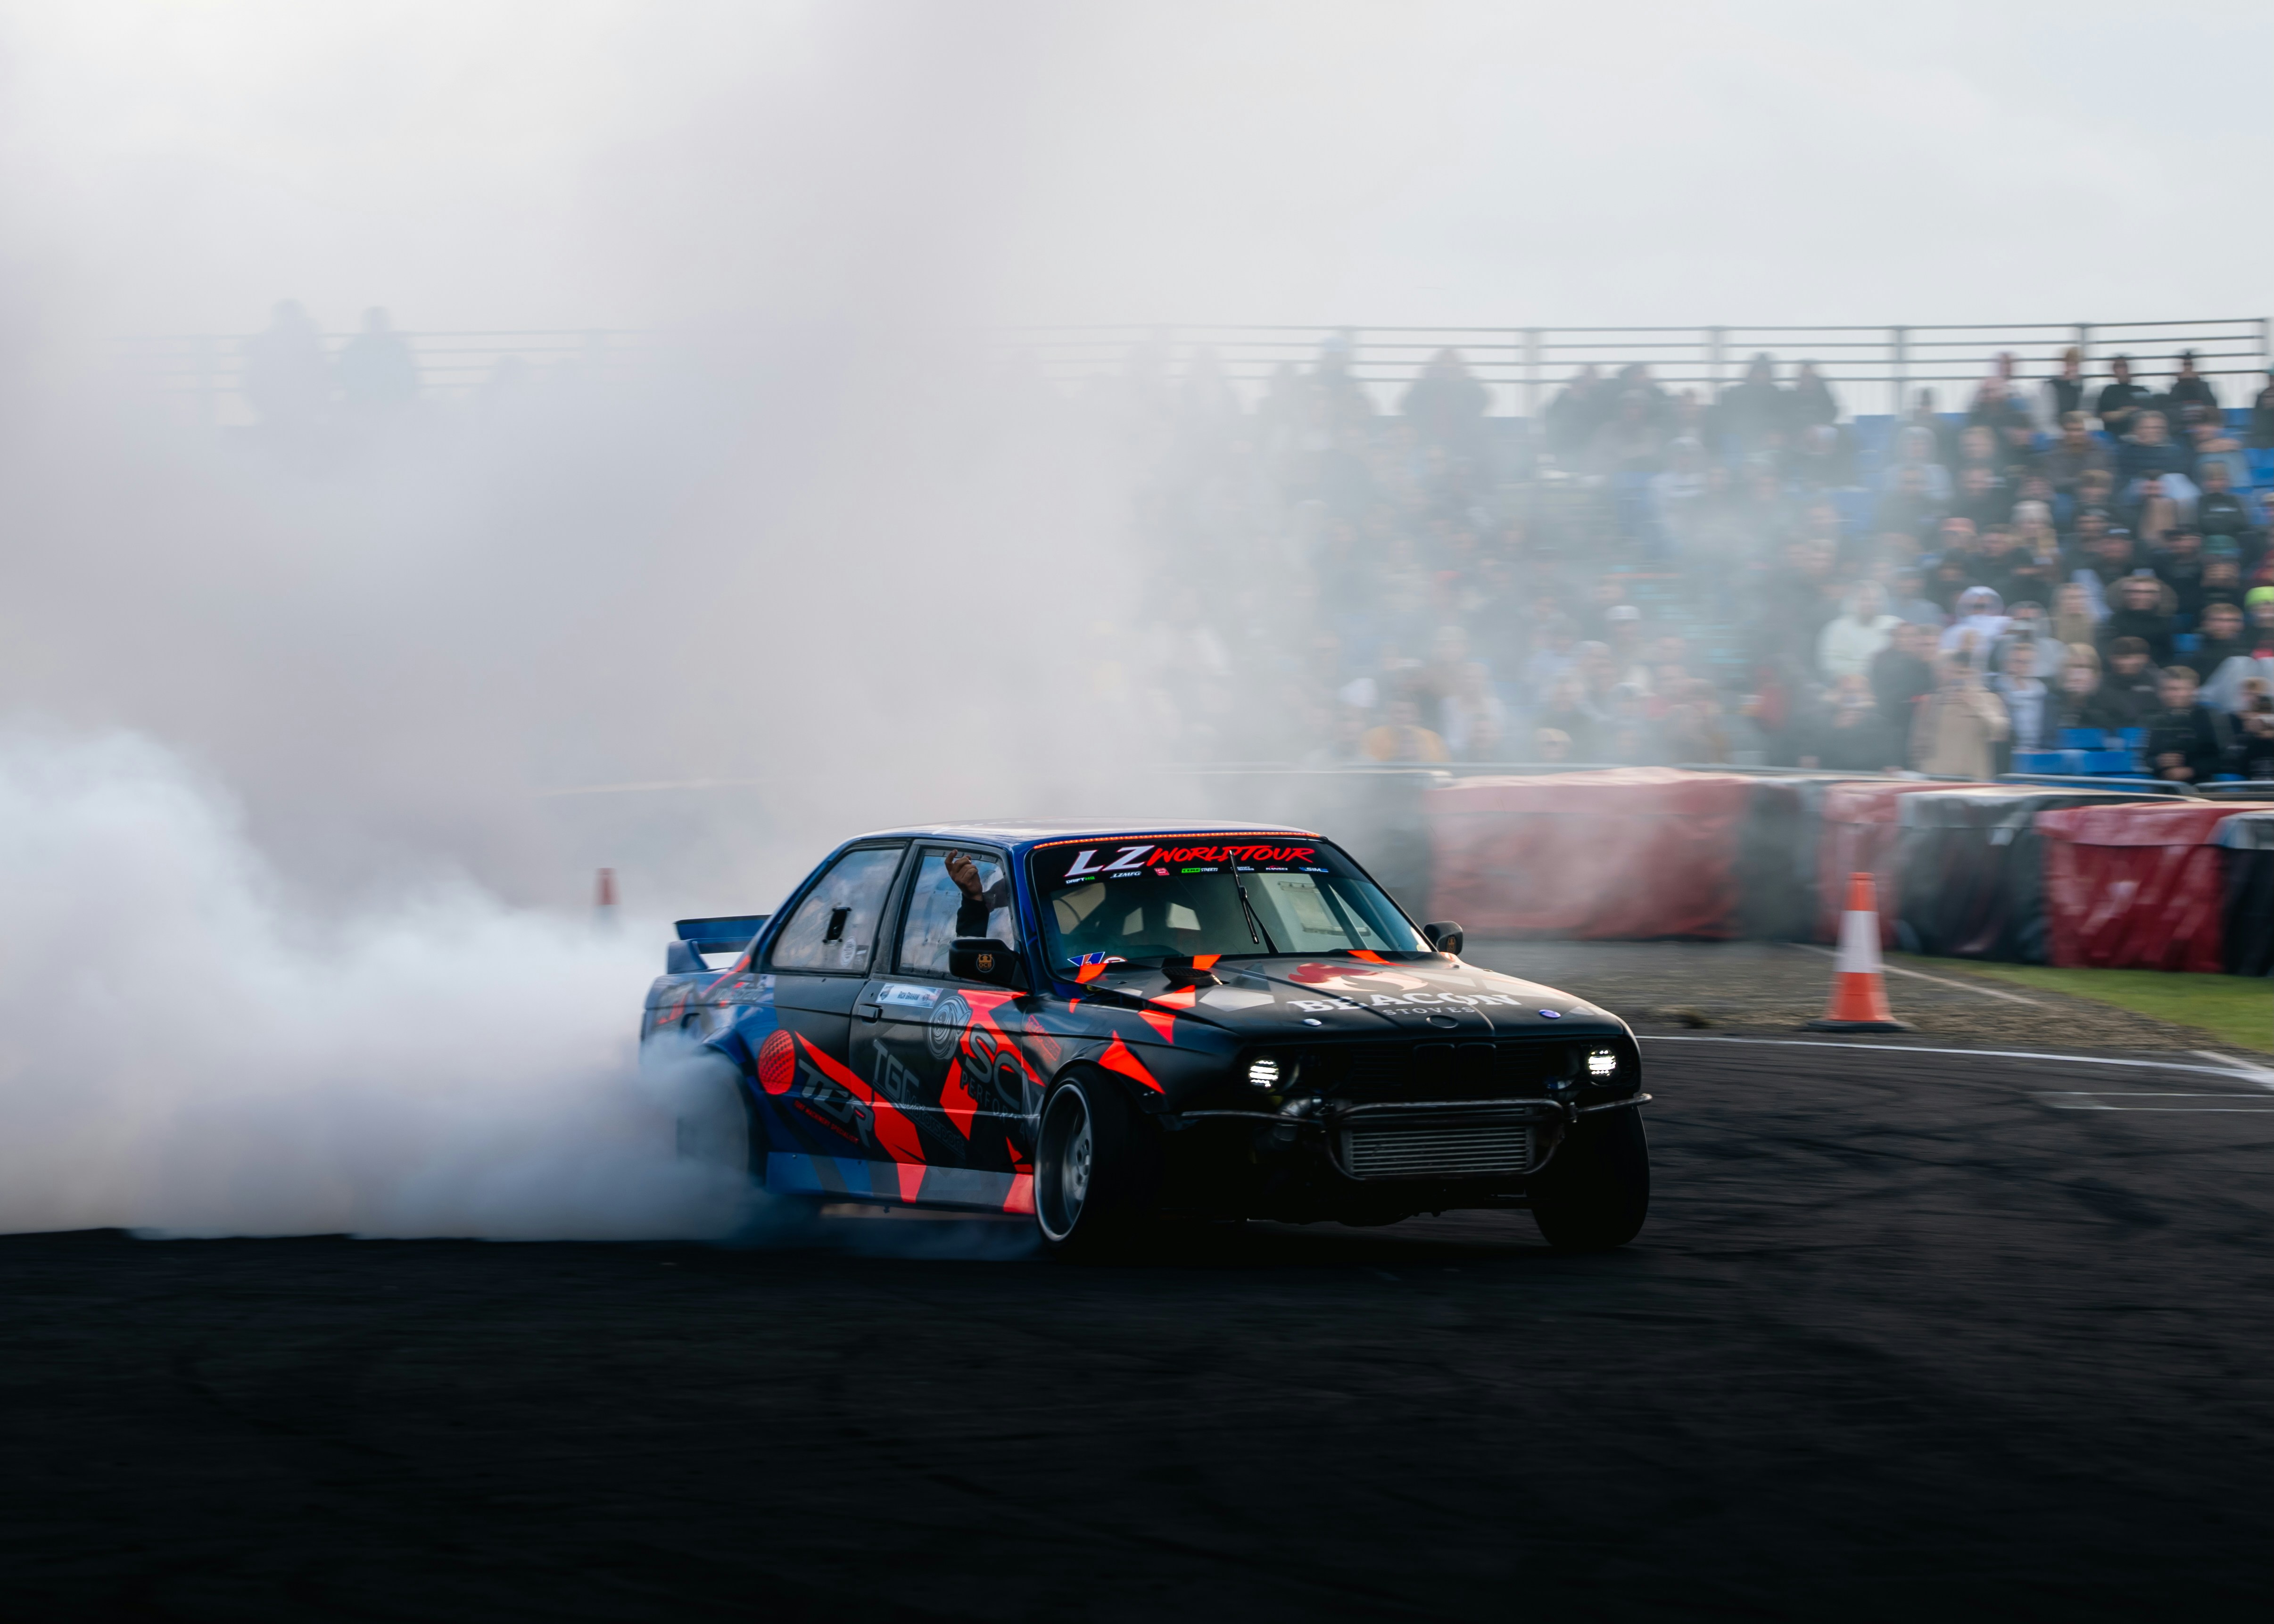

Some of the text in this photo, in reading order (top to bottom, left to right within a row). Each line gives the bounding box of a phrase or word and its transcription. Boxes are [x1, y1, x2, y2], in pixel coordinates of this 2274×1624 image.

[1063, 845, 1156, 877] LZ
[1286, 992, 1522, 1013] BEACON
[1382, 1006, 1475, 1016] STOVES
